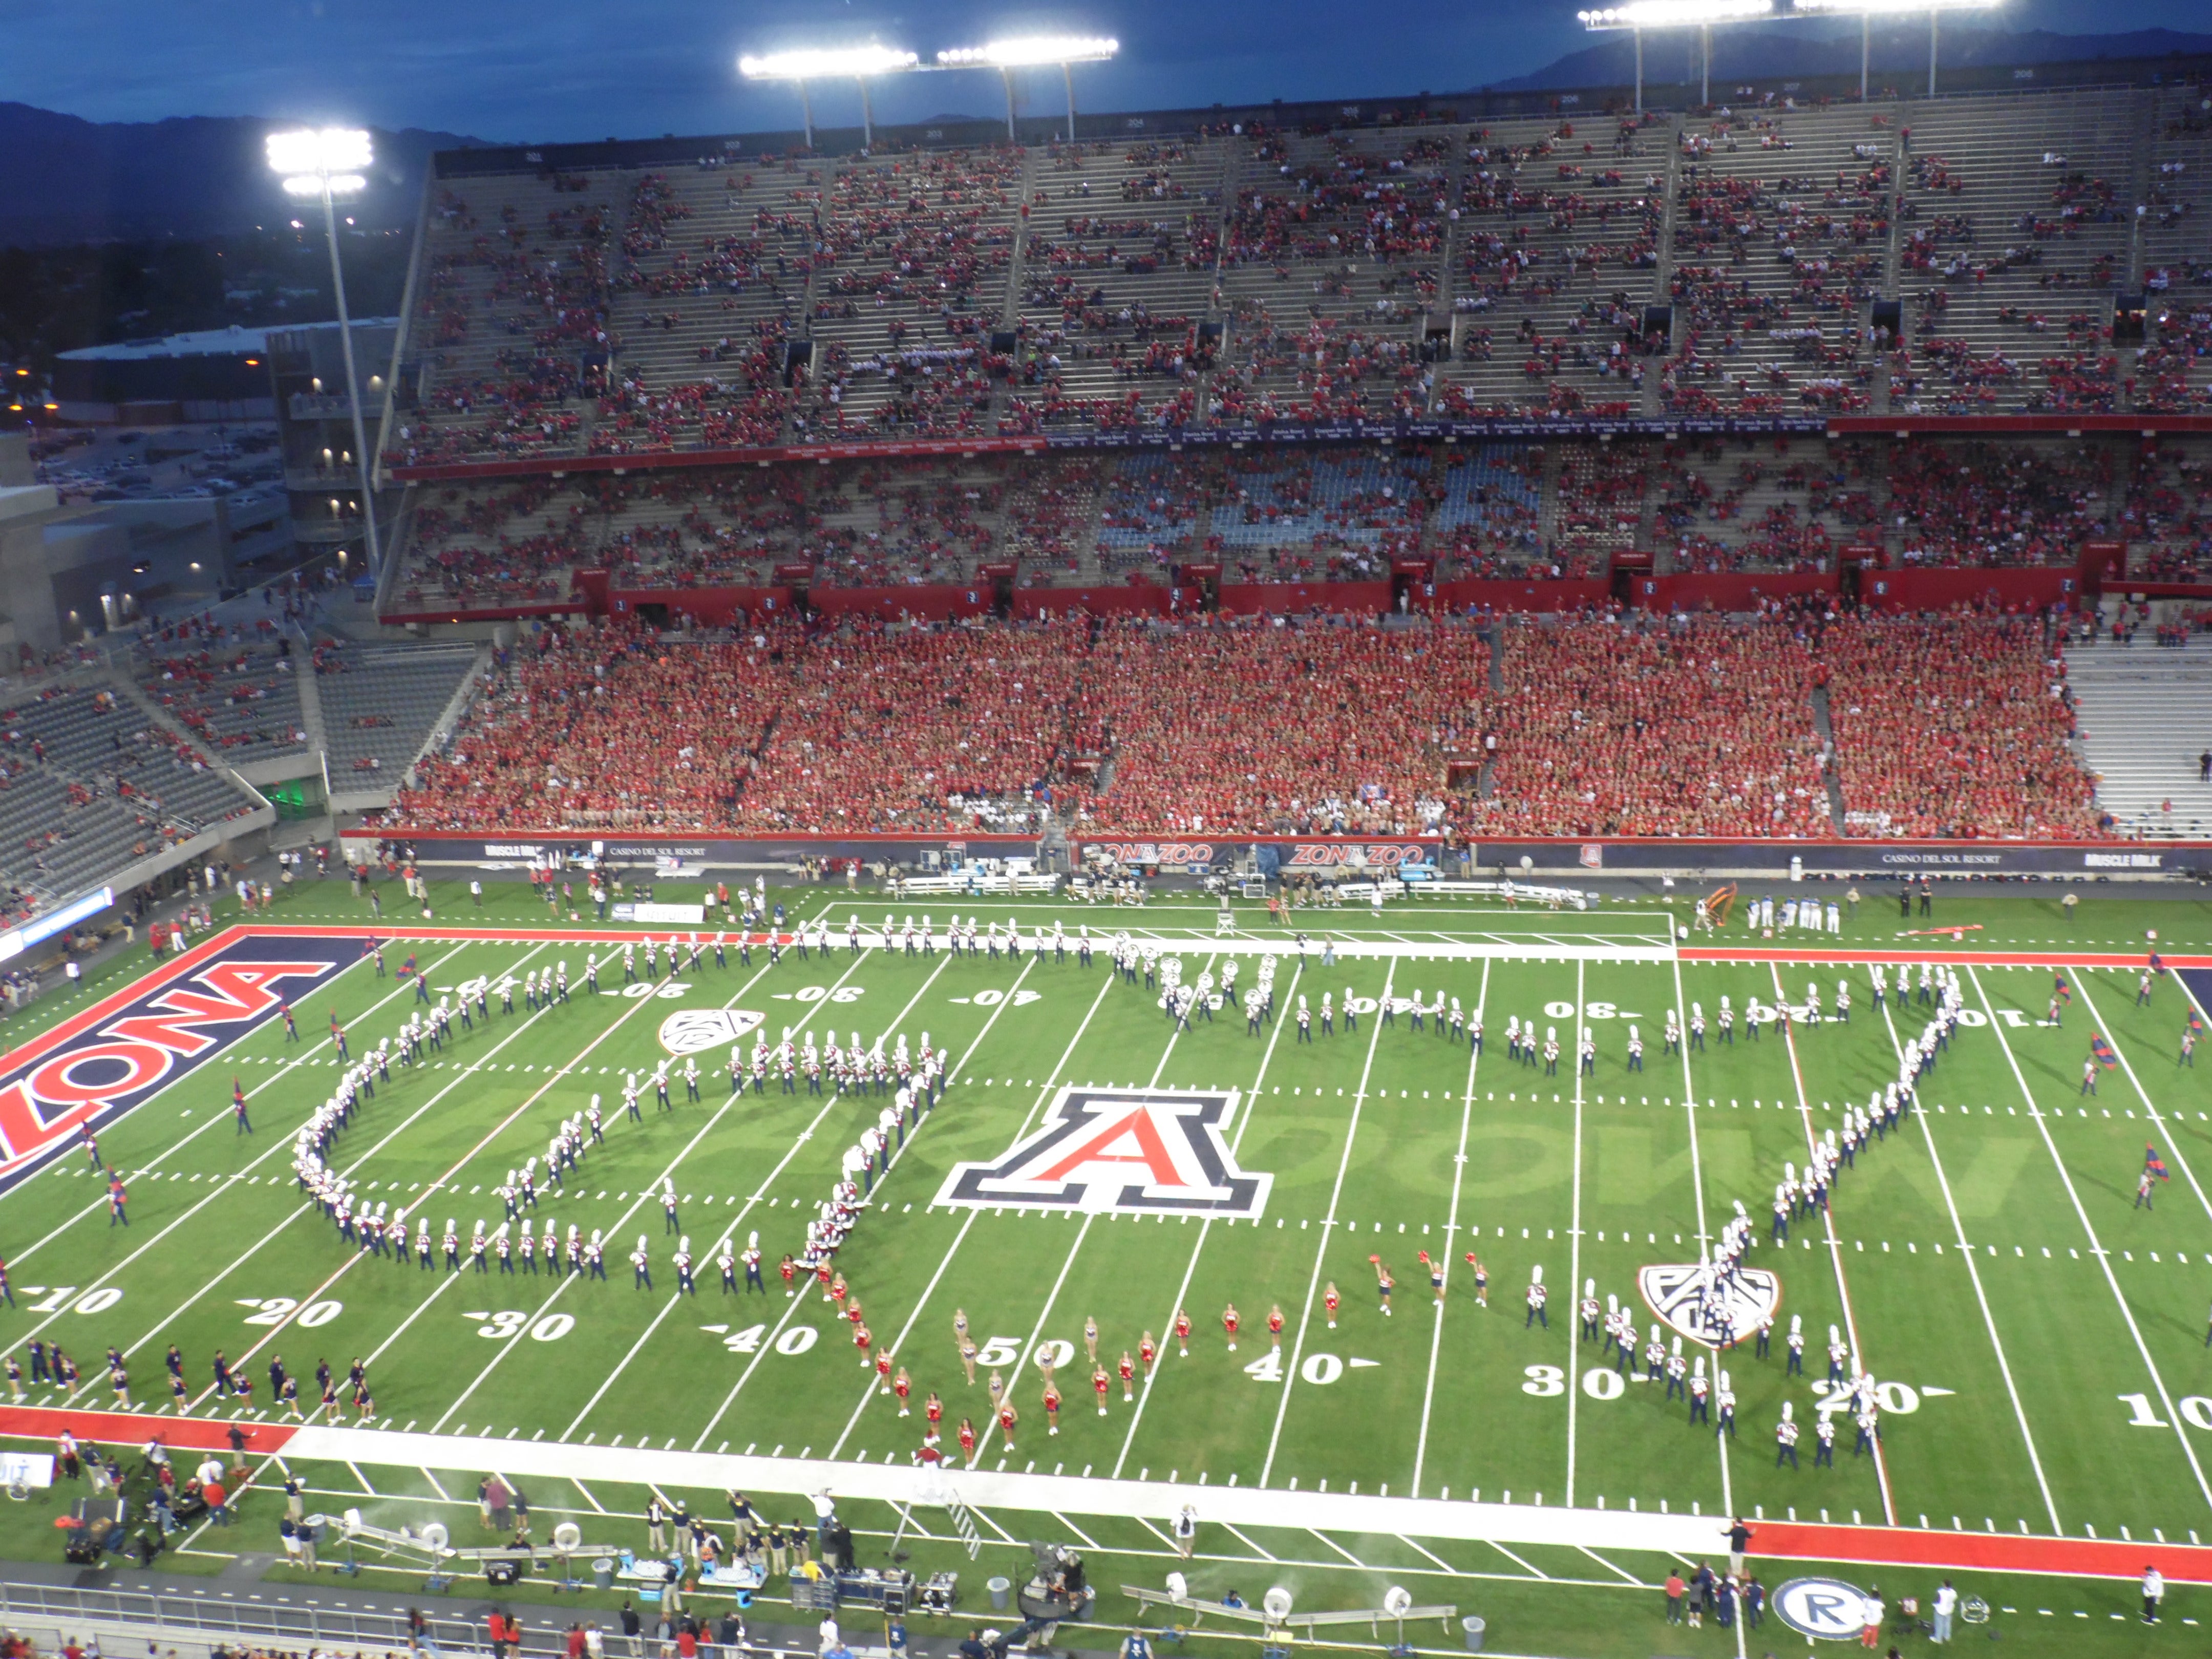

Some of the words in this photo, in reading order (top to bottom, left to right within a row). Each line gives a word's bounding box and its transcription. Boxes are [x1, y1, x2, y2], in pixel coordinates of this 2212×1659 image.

[484, 845, 520, 857] MUSCLE
[610, 847, 641, 856] CASINO
[642, 847, 657, 856] DEL
[657, 847, 673, 856] SOL
[674, 848, 707, 856] RESORT
[1158, 844, 1213, 864] ZOO
[1366, 845, 1423, 866] ZOO
[1882, 854, 1921, 863] CASINO
[1922, 855, 1942, 863] DEL
[1942, 855, 1962, 863] SOL
[1962, 855, 2002, 864] RESORT
[2085, 854, 2131, 867] MUSCLE
[932, 1086, 1274, 1219] A
[29, 1287, 122, 1314] 10
[244, 1298, 343, 1327] 20
[478, 1311, 575, 1341] 30
[723, 1324, 818, 1355] 40
[1244, 1352, 1343, 1384] 40
[1522, 1365, 1625, 1400] 30
[1804, 1593, 1848, 1626] R
